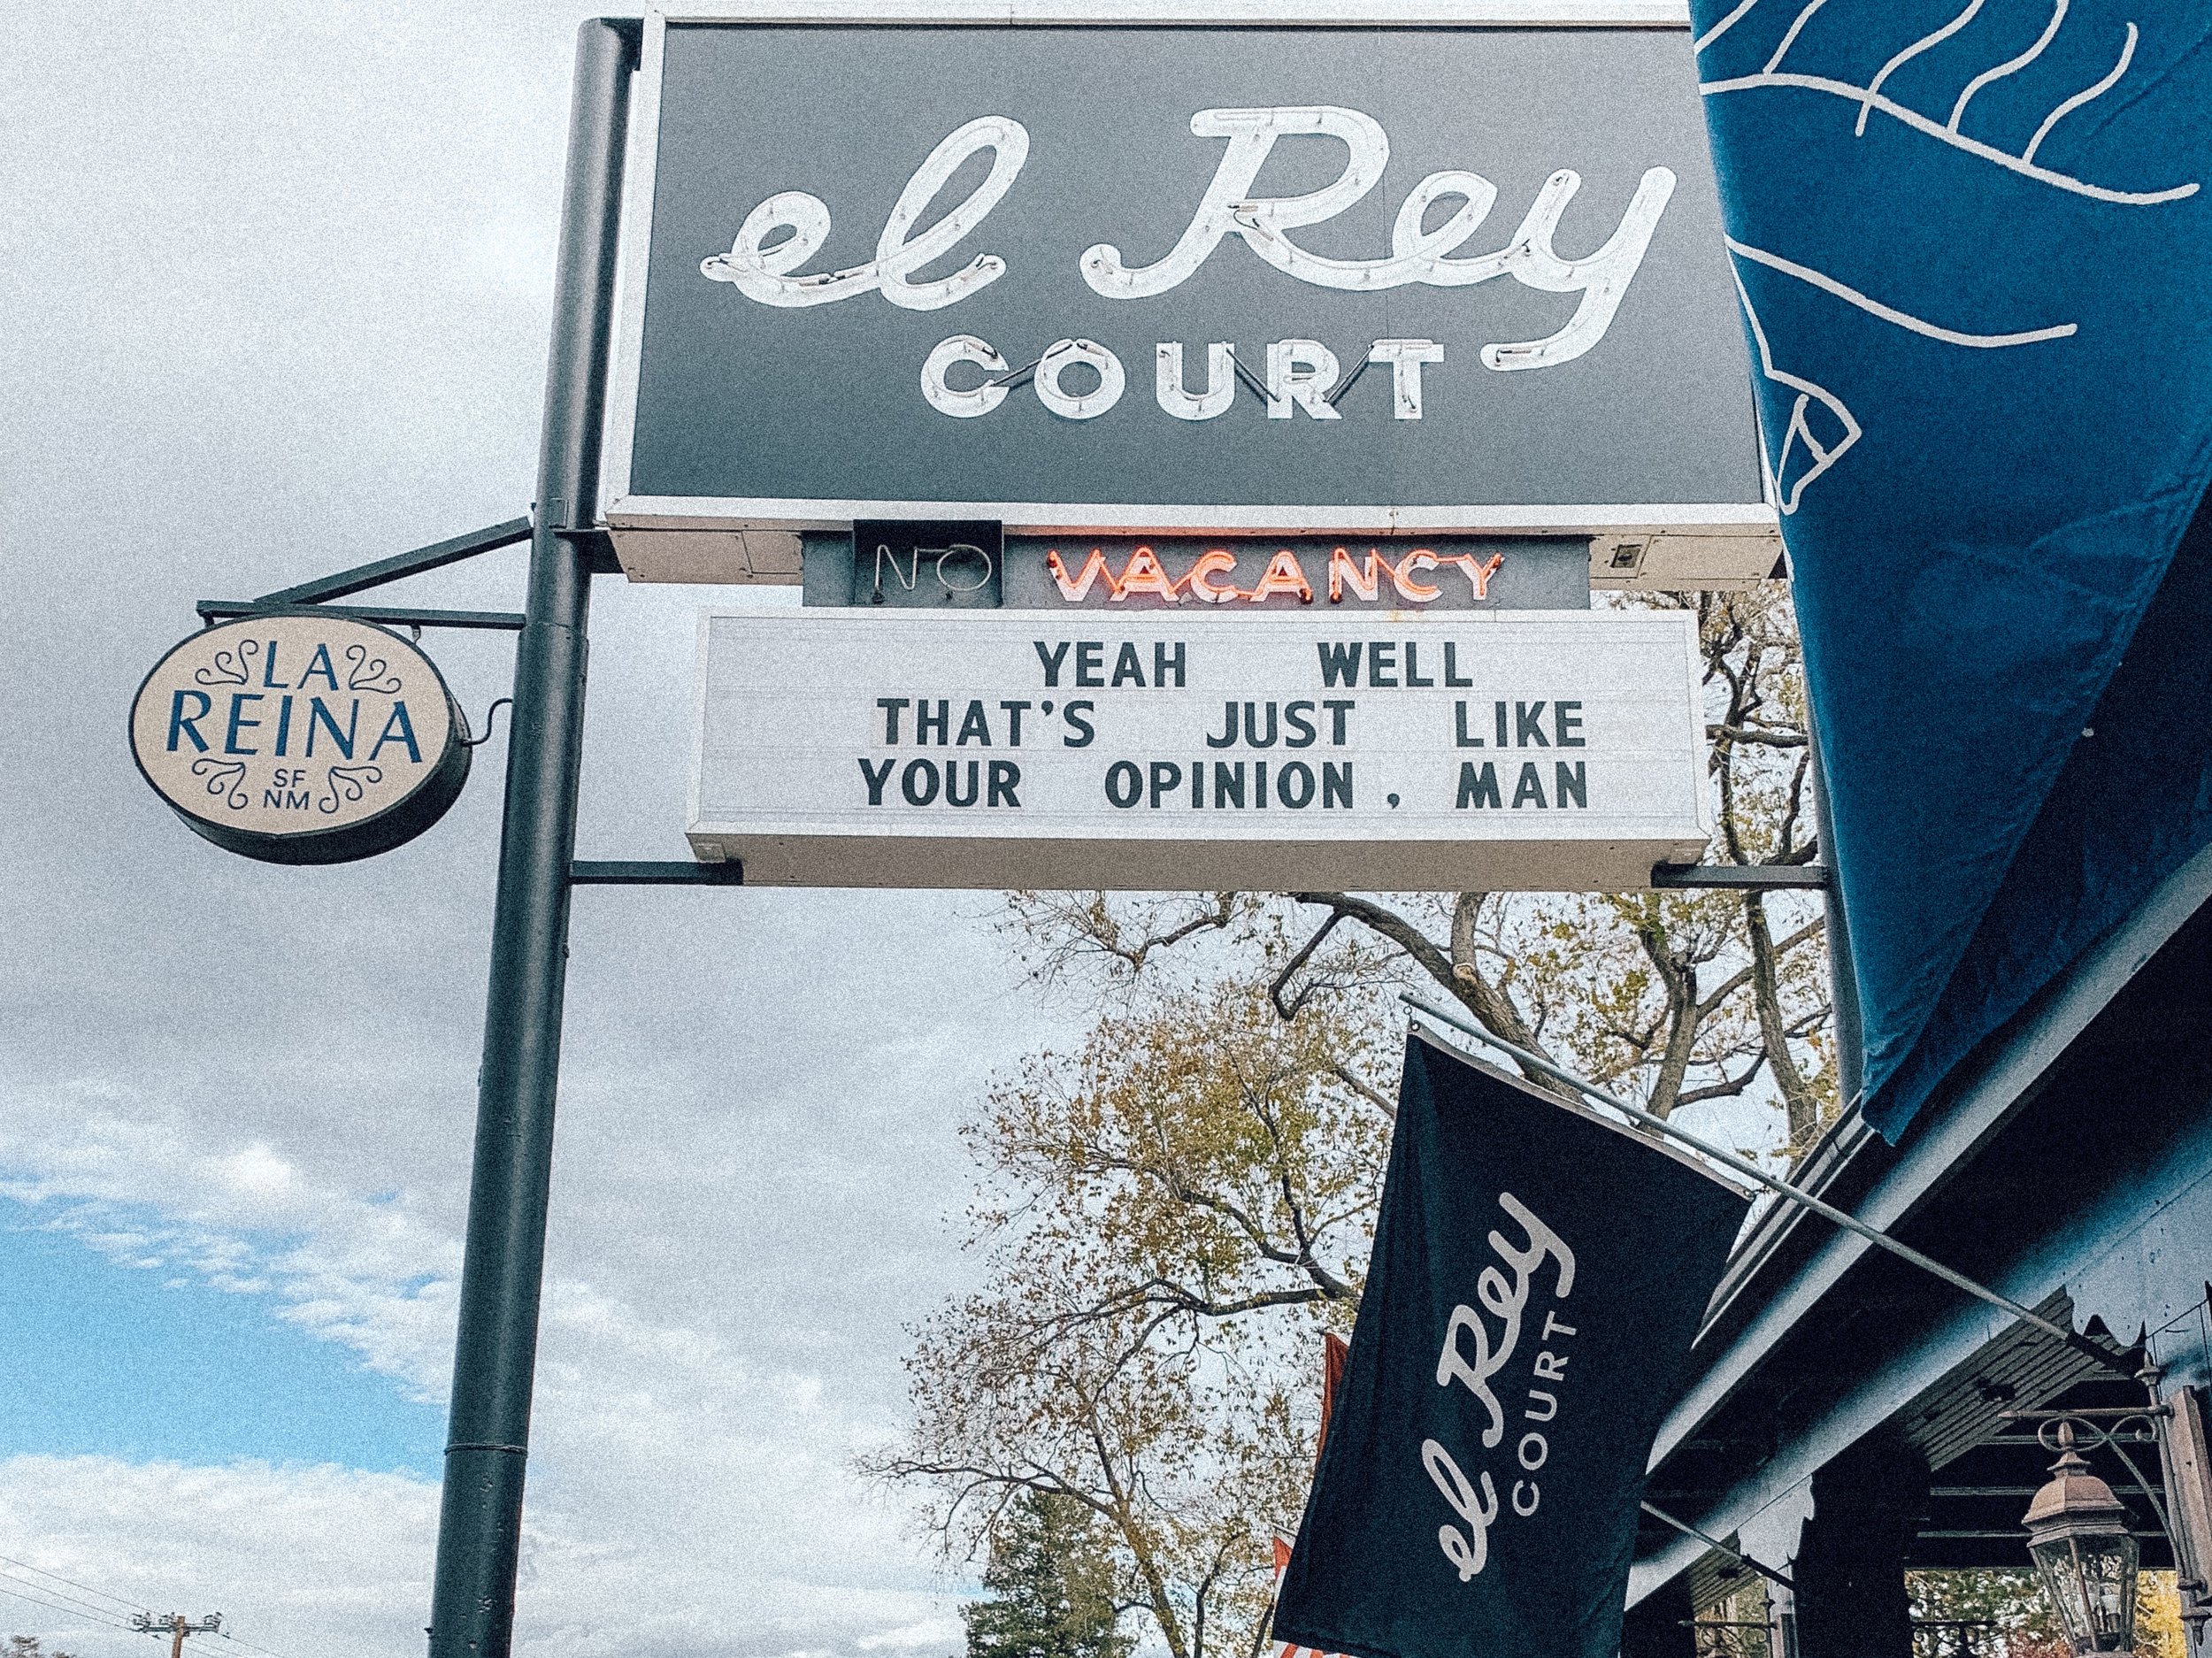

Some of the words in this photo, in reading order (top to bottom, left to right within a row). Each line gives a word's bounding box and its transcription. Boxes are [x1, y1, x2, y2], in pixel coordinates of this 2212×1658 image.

[700, 115, 1030, 311] el
[1079, 105, 1677, 370] Rey
[920, 334, 1445, 420] COURT
[872, 543, 993, 593] NO
[1047, 546, 1504, 603] VACANCY
[262, 640, 339, 692] LA
[1033, 641, 1187, 688] YEAH
[1317, 641, 1472, 688] WELL
[165, 689, 423, 764] REINA
[877, 698, 1095, 748] THAT'S
[1205, 700, 1356, 748] JUST
[1455, 701, 1586, 748] LIKE
[262, 789, 311, 810] NM
[273, 768, 307, 789] SF
[858, 758, 1023, 808] YOUR
[1455, 761, 1587, 810] MAN
[1436, 1192, 1576, 1448] Rey
[1512, 1310, 1577, 1516] COURT
[1421, 1438, 1498, 1583] el
